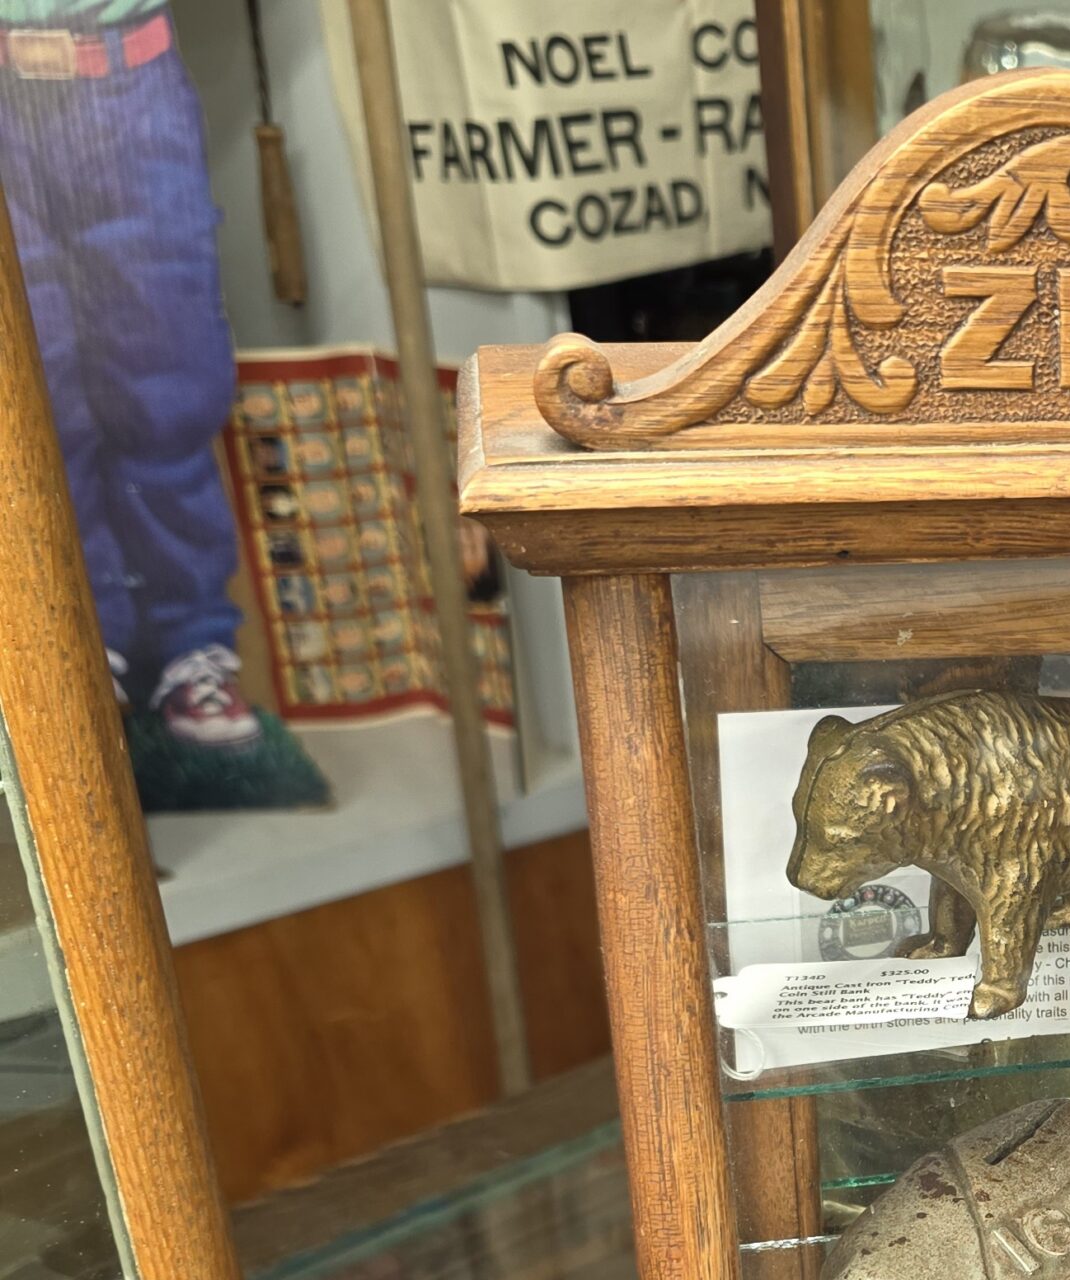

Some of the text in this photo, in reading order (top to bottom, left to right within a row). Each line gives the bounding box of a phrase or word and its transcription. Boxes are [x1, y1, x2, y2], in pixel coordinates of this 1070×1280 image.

[500, 30, 652, 88] NOEL
[408, 106, 645, 183] FARMER
[1047, 941, 1070, 953] this
[880, 968, 930, 977] $325.00
[1043, 973, 1066, 986] this
[779, 987, 871, 998] Coin Still Bank
[1054, 989, 1069, 1002] all
[1036, 1005, 1068, 1018] traits
